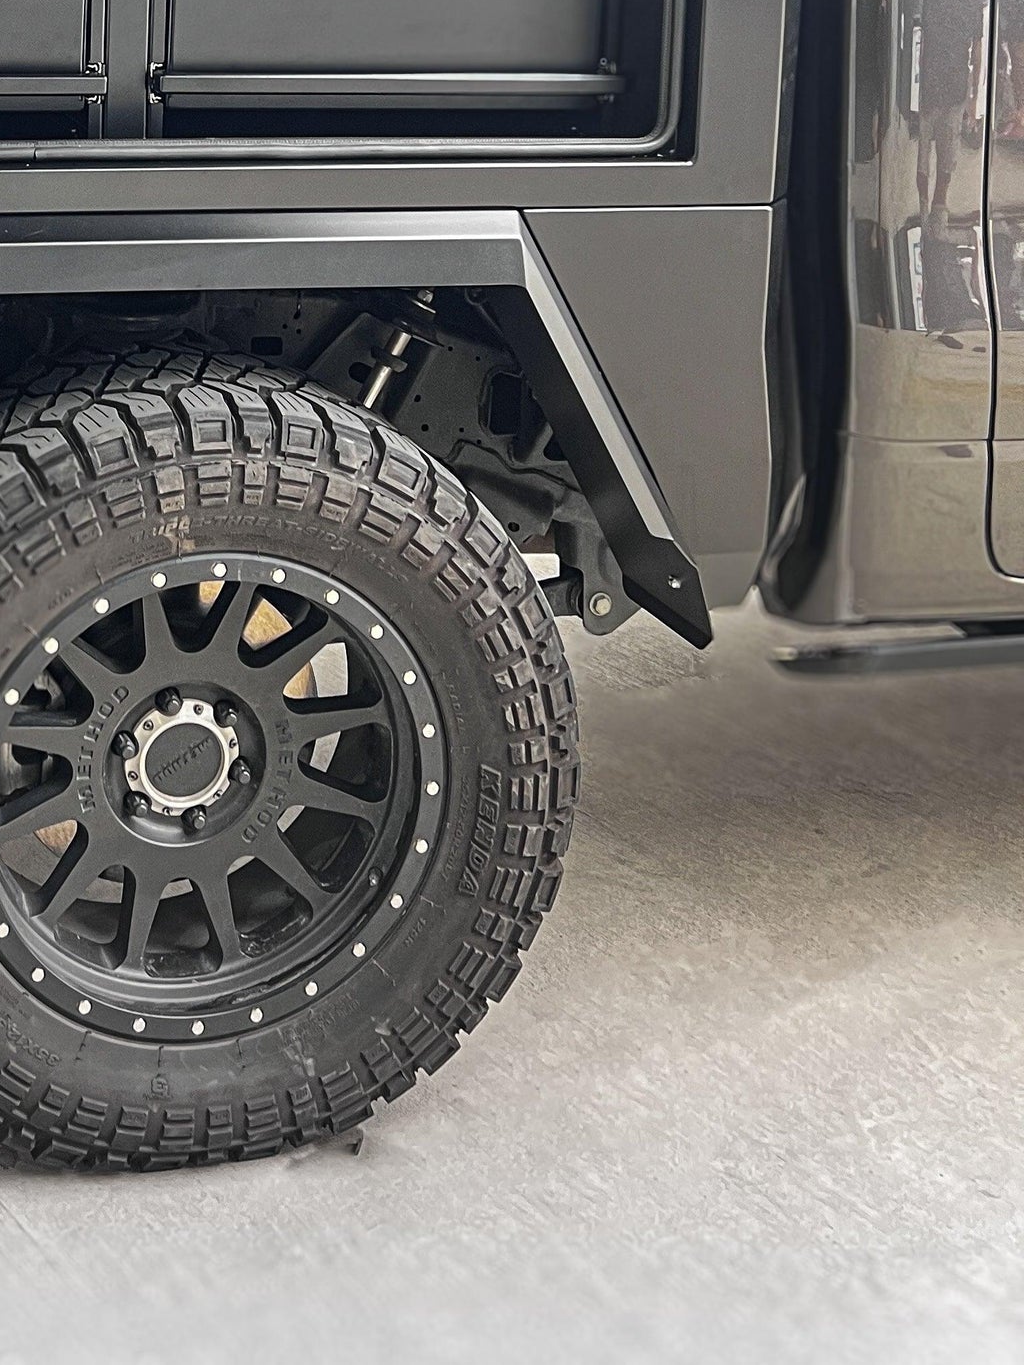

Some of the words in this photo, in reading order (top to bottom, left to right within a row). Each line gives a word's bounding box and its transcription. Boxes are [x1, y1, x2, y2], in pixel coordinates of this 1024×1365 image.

[77, 686, 129, 813] METHOD
[242, 718, 293, 843] METHOD
[457, 763, 503, 897] KENDA
